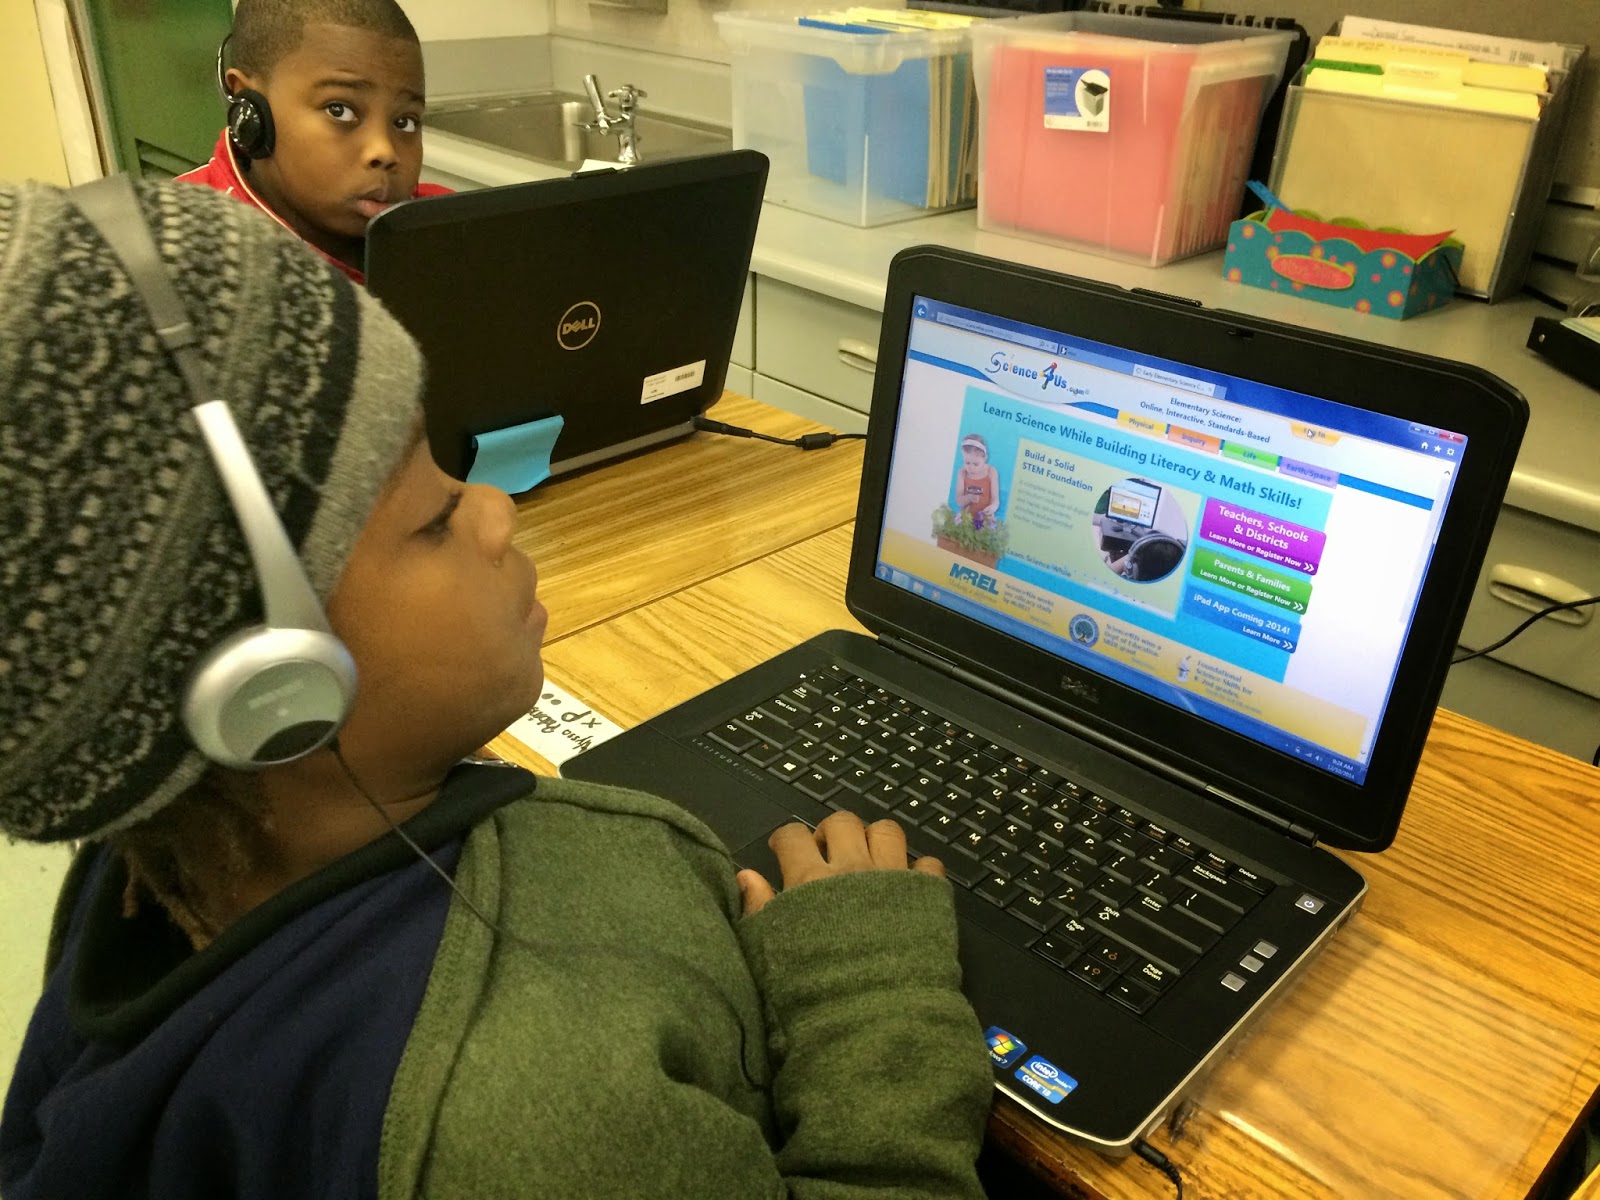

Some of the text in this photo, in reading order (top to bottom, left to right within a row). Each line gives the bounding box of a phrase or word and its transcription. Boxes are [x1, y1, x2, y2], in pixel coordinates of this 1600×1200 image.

[562, 318, 595, 335] DELL
[1170, 397, 1242, 423] Elementary Science:
[1129, 417, 1155, 431] Physical
[1140, 401, 1271, 443] Online, Interactive, Standards-Based
[1181, 433, 1206, 446] Inquiry
[983, 402, 1302, 510] Learn Science While Building Literacy & Math Skills!
[1024, 449, 1045, 463] Build
[1054, 459, 1076, 472] Solid
[1242, 450, 1257, 460] Life
[1022, 461, 1093, 492] STEM Foundation
[1286, 463, 1332, 482] Earth/Space
[1218, 505, 1309, 543] Teachers, Schools
[1233, 523, 1289, 550] & Districts
[1208, 531, 1302, 568] Learn More or Register Now
[1214, 559, 1291, 592] Parents & Families
[1200, 569, 1291, 607] Learn More or Register Now
[1194, 593, 1291, 635] iPad App Coming 2014!
[1242, 626, 1281, 645] Learn More
[1120, 808, 1132, 817] F12
[1148, 823, 1166, 834] Home
[1178, 838, 1190, 846] End
[1194, 865, 1227, 885] Backspace
[1238, 868, 1258, 880] Delete
[1028, 896, 1042, 906] Ctrl
[1143, 896, 1162, 909] Enter
[1104, 906, 1120, 918] Shift
[1070, 920, 1085, 931] Page
[1142, 968, 1162, 981] Down
[1147, 963, 1164, 976] Page
[1034, 1062, 1056, 1078] intel
[1022, 1074, 1042, 1091] CORE
